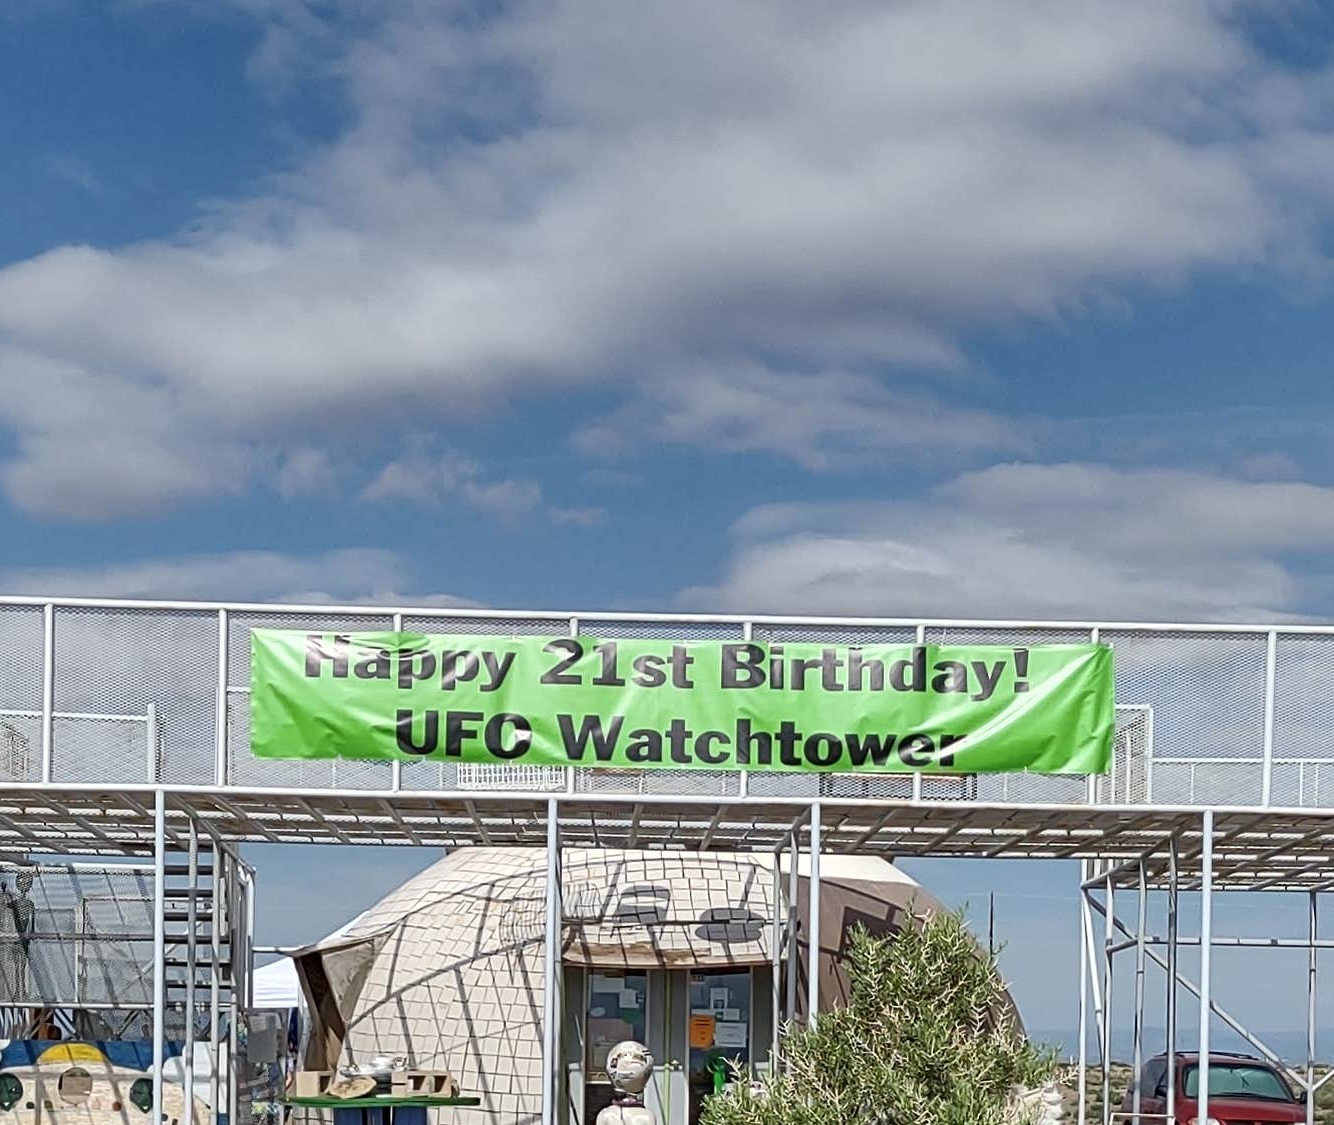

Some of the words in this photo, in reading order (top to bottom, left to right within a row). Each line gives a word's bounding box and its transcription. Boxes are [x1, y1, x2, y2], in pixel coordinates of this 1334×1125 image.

[304, 634, 516, 692] Happy
[540, 638, 695, 689] 21st
[720, 643, 1031, 701] Birthday!
[556, 713, 968, 768] Watchtower
